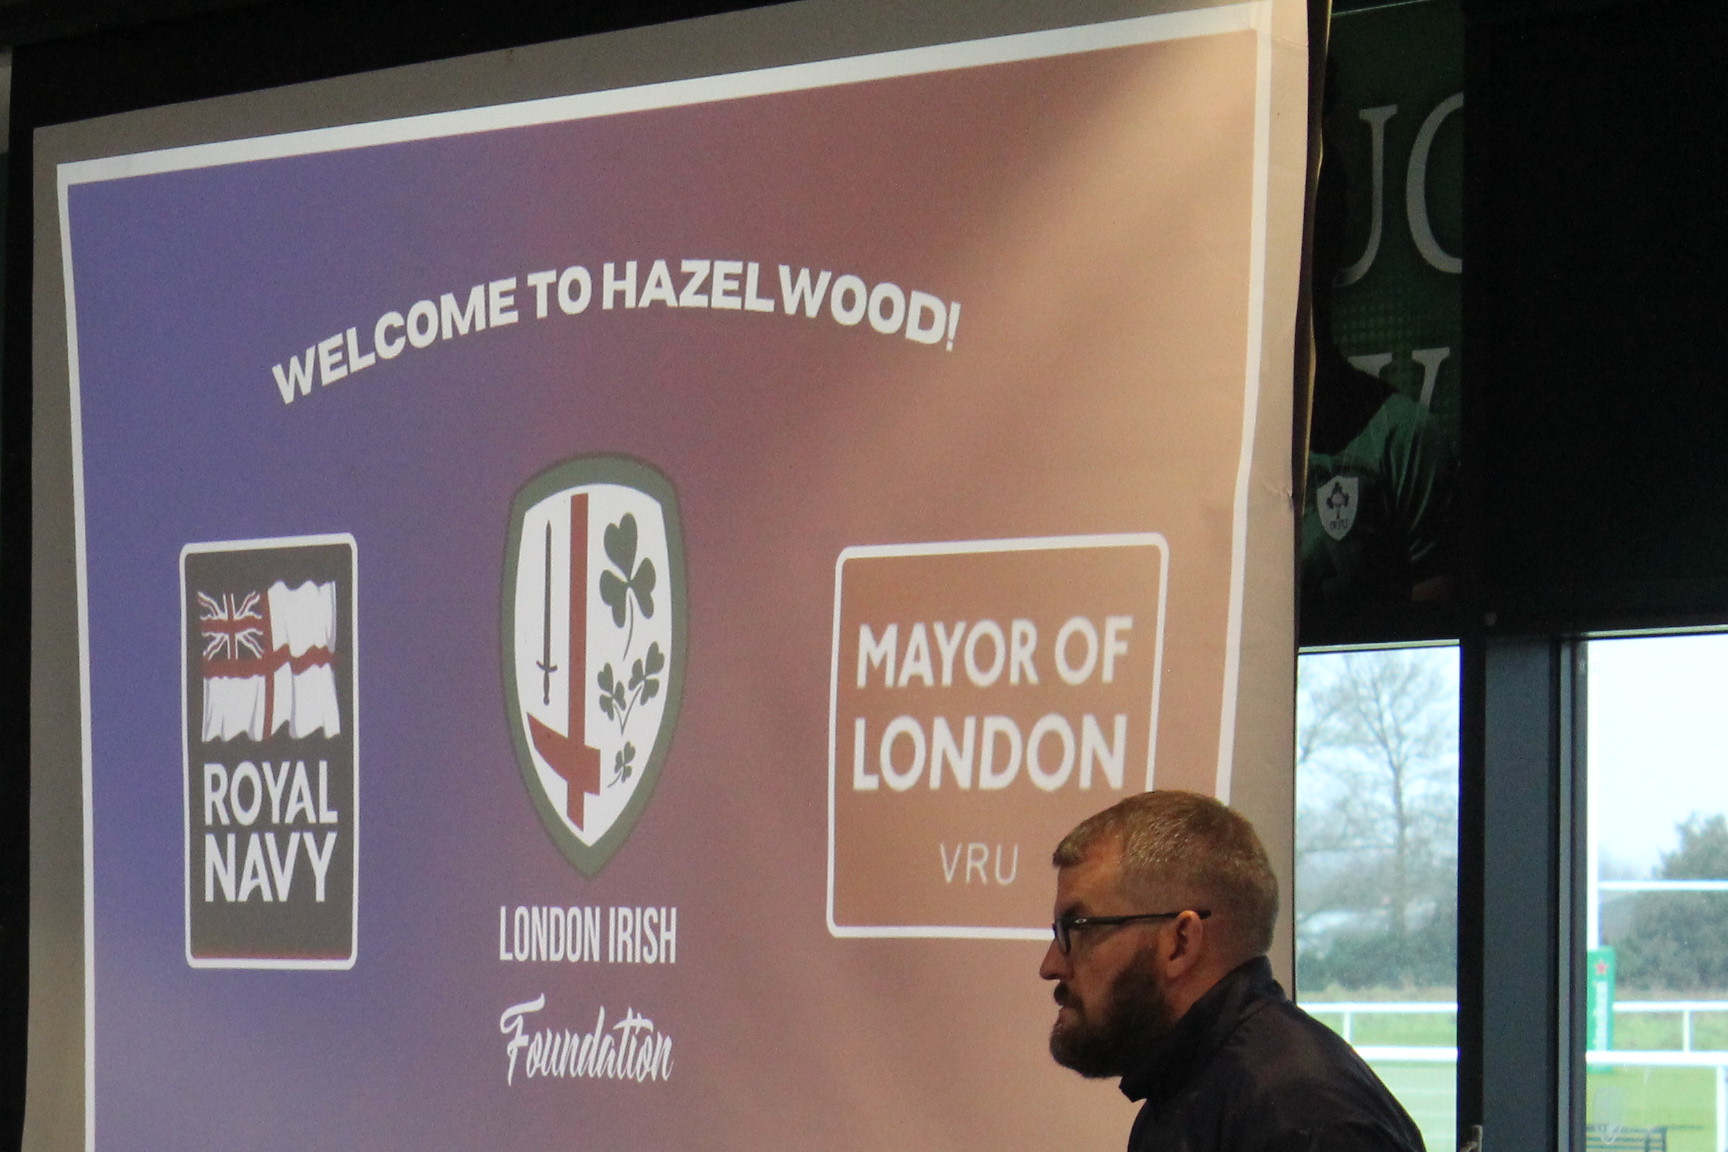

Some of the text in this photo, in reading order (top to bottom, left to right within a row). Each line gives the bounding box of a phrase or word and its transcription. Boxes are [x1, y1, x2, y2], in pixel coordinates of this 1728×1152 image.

[272, 277, 520, 404] WELCOME
[527, 265, 592, 318] TO
[857, 615, 1134, 690] MAYOR OF
[852, 713, 1128, 792] LONDON
[203, 760, 339, 826] ROYAL
[204, 832, 338, 903] NAVY
[939, 842, 1020, 885] VRU
[499, 906, 677, 964] LONDON IRISH
[500, 993, 674, 1086] Foundation
